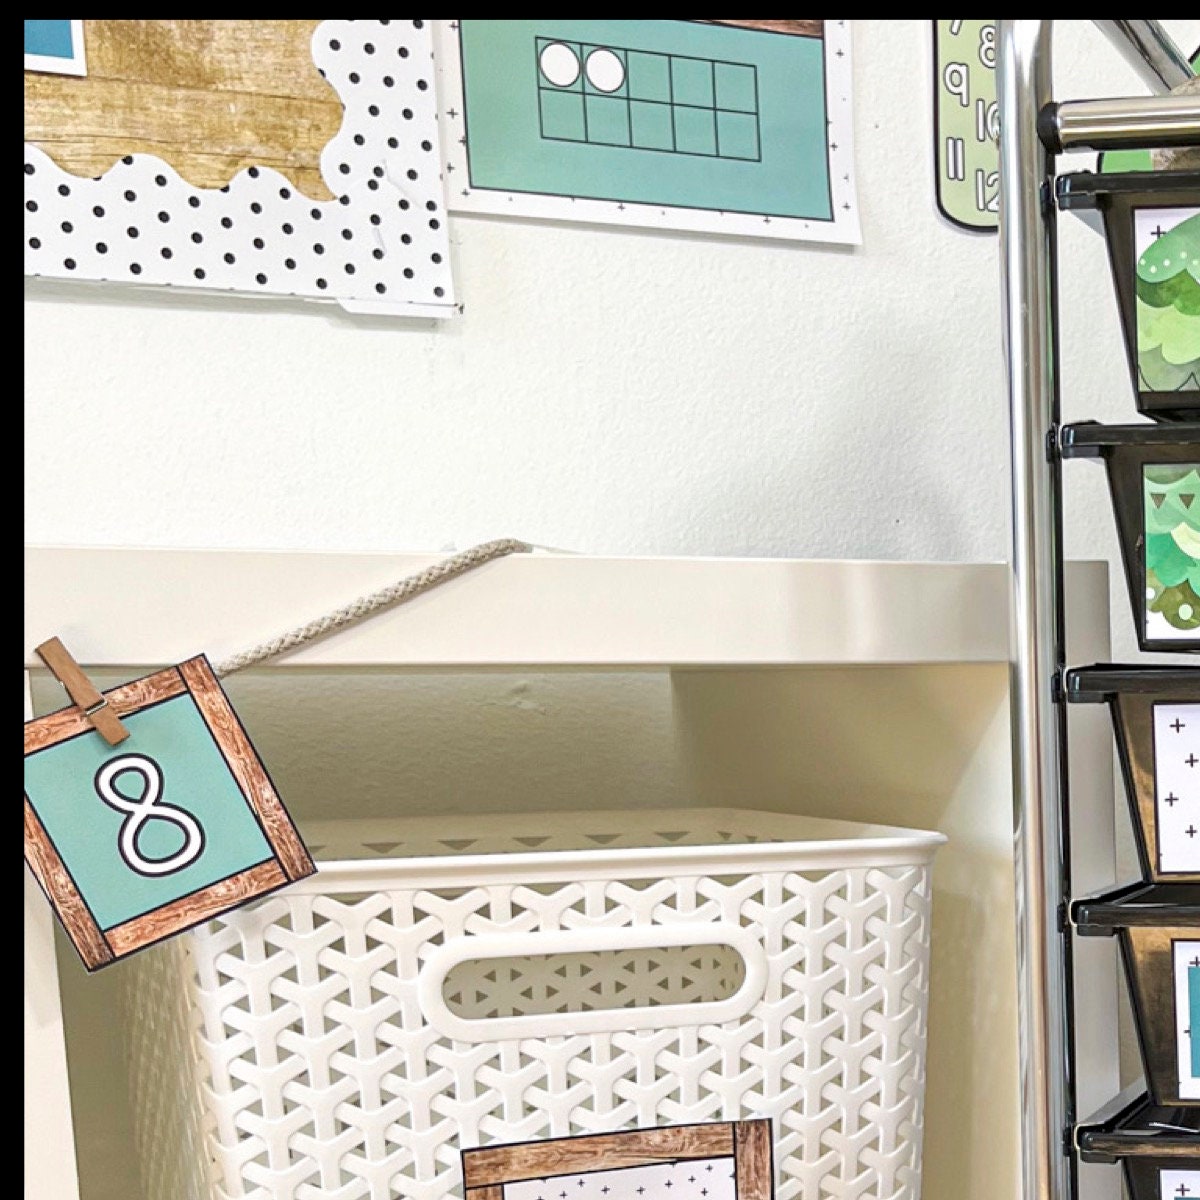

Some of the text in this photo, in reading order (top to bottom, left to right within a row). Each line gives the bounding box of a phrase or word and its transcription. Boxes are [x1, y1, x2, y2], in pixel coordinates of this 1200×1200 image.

[943, 62, 969, 107] 9
[946, 137, 965, 181] 11
[94, 753, 206, 877] 8
